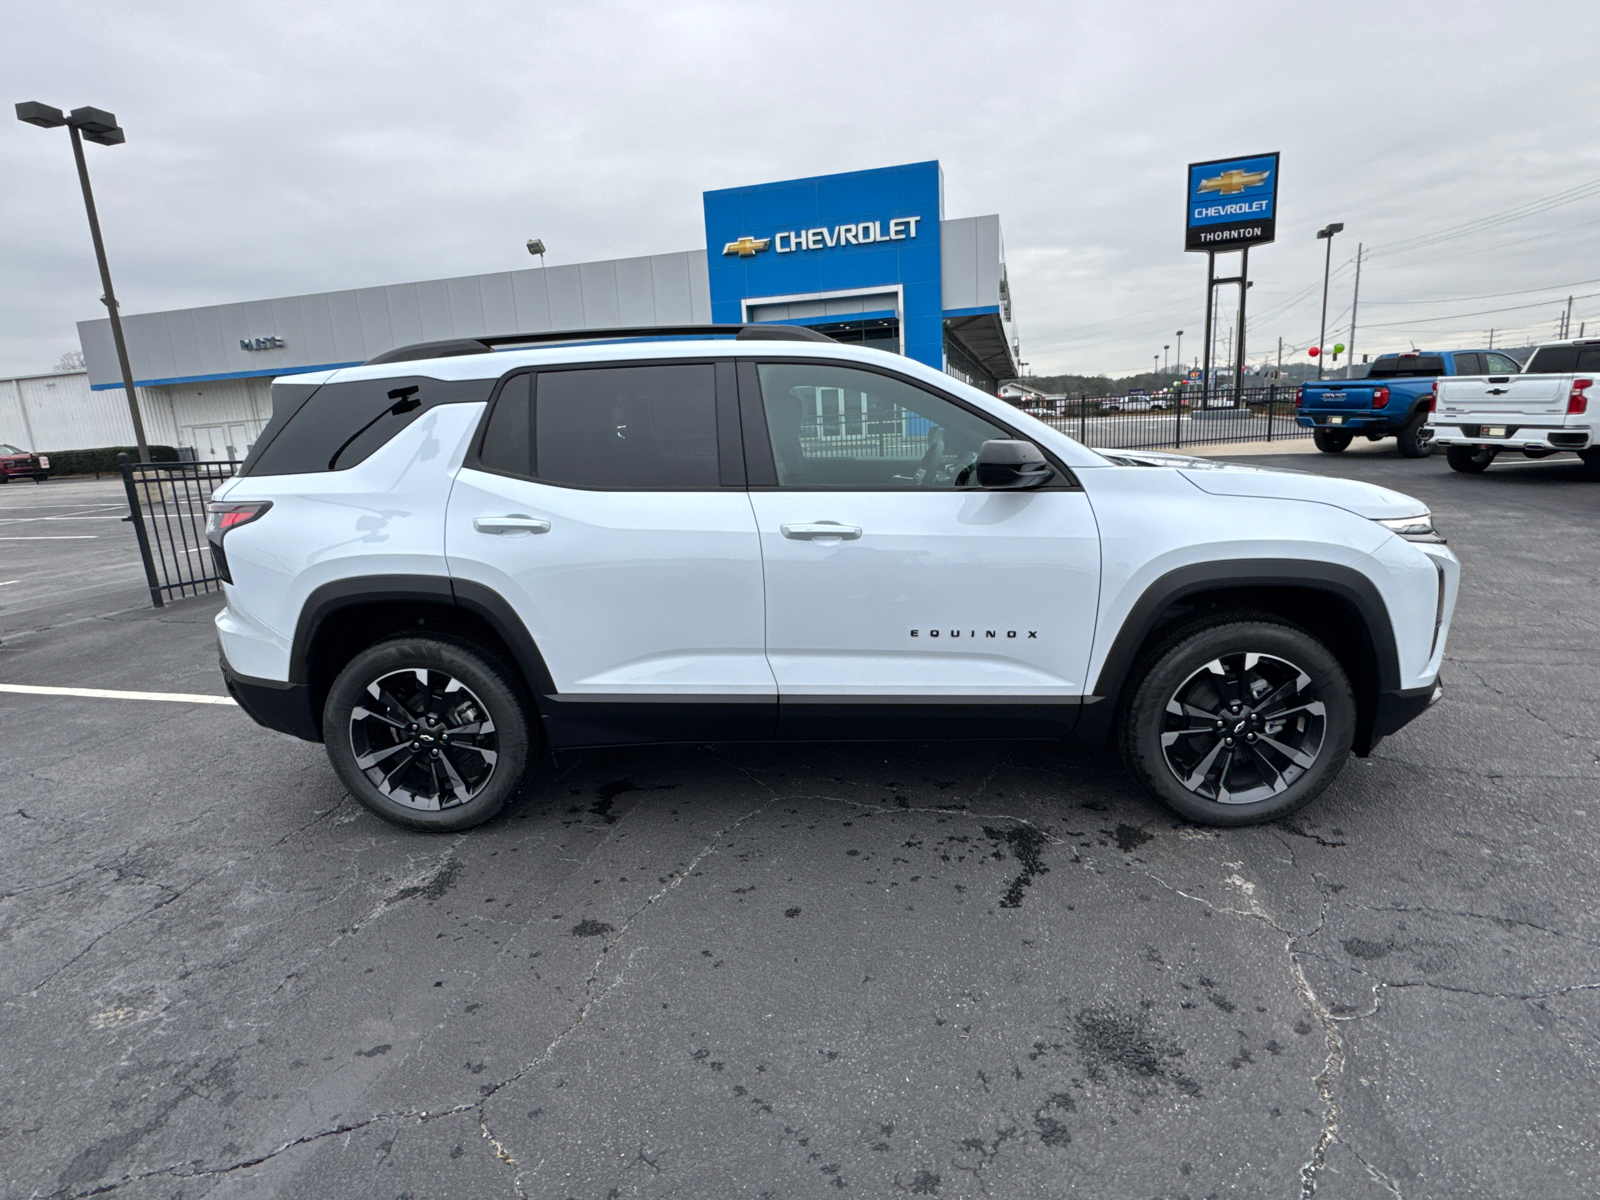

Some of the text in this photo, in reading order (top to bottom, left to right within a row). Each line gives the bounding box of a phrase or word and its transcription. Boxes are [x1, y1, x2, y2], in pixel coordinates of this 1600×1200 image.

[1194, 200, 1269, 219] CHEVROLET
[775, 216, 921, 254] CHEVROLET
[1200, 227, 1262, 242] THORNTON
[910, 629, 1038, 639] EQUINOX
